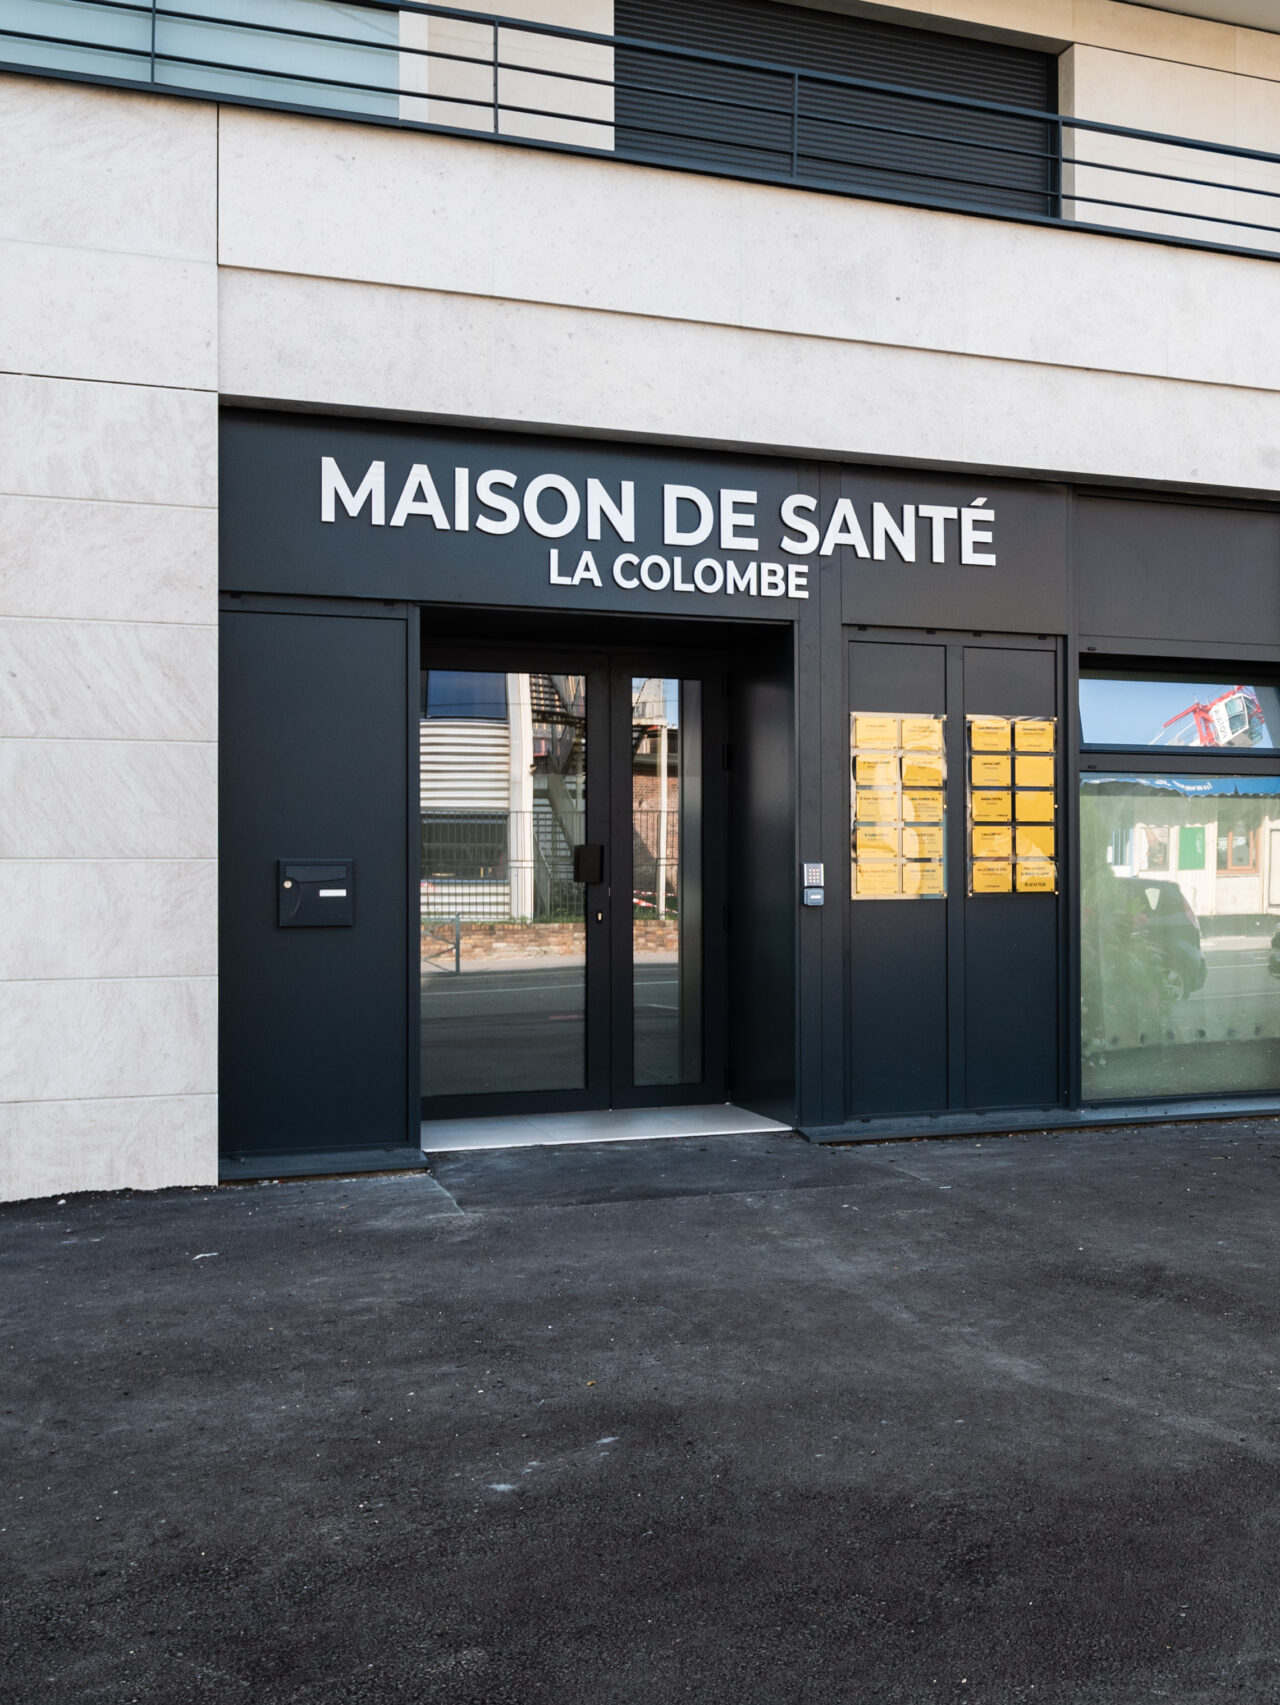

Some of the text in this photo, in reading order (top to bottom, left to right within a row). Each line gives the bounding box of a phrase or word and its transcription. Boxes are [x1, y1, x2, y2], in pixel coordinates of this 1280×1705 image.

[320, 455, 998, 568] MAISON DE SANTÉ
[549, 548, 810, 600] LA COLOMBE
